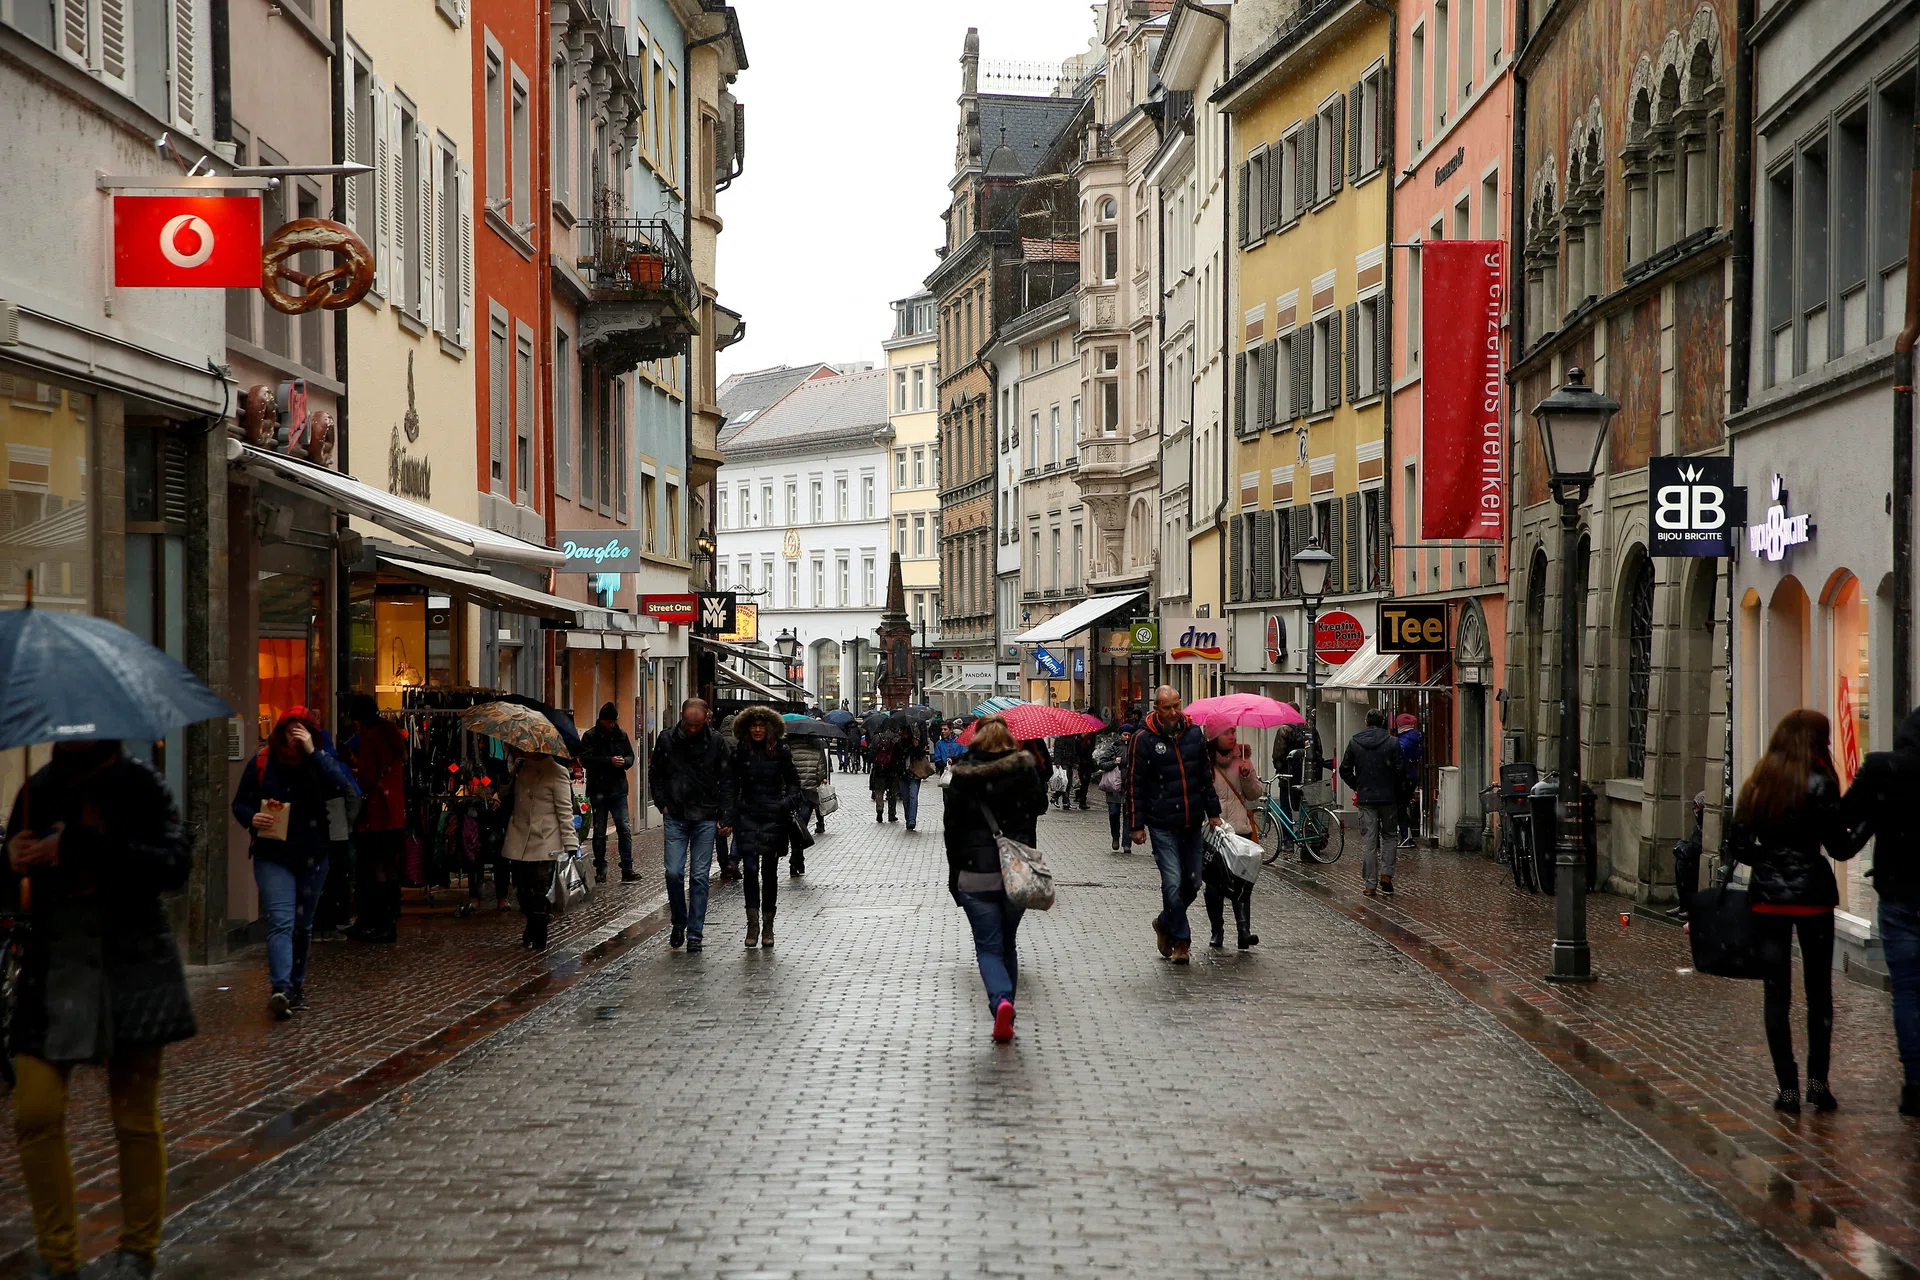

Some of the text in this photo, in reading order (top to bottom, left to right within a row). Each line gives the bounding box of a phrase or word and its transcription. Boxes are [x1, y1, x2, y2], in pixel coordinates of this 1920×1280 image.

[1657, 532, 1723, 541] BIJOU BRIGITTE
[563, 539, 632, 564] Douglas
[648, 603, 692, 612] Street One
[1318, 621, 1355, 632] Kreativ
[1383, 611, 1443, 643] Tee
[1179, 625, 1217, 647] dm
[1335, 630, 1362, 640] Point
[1038, 653, 1061, 674] Mimi
